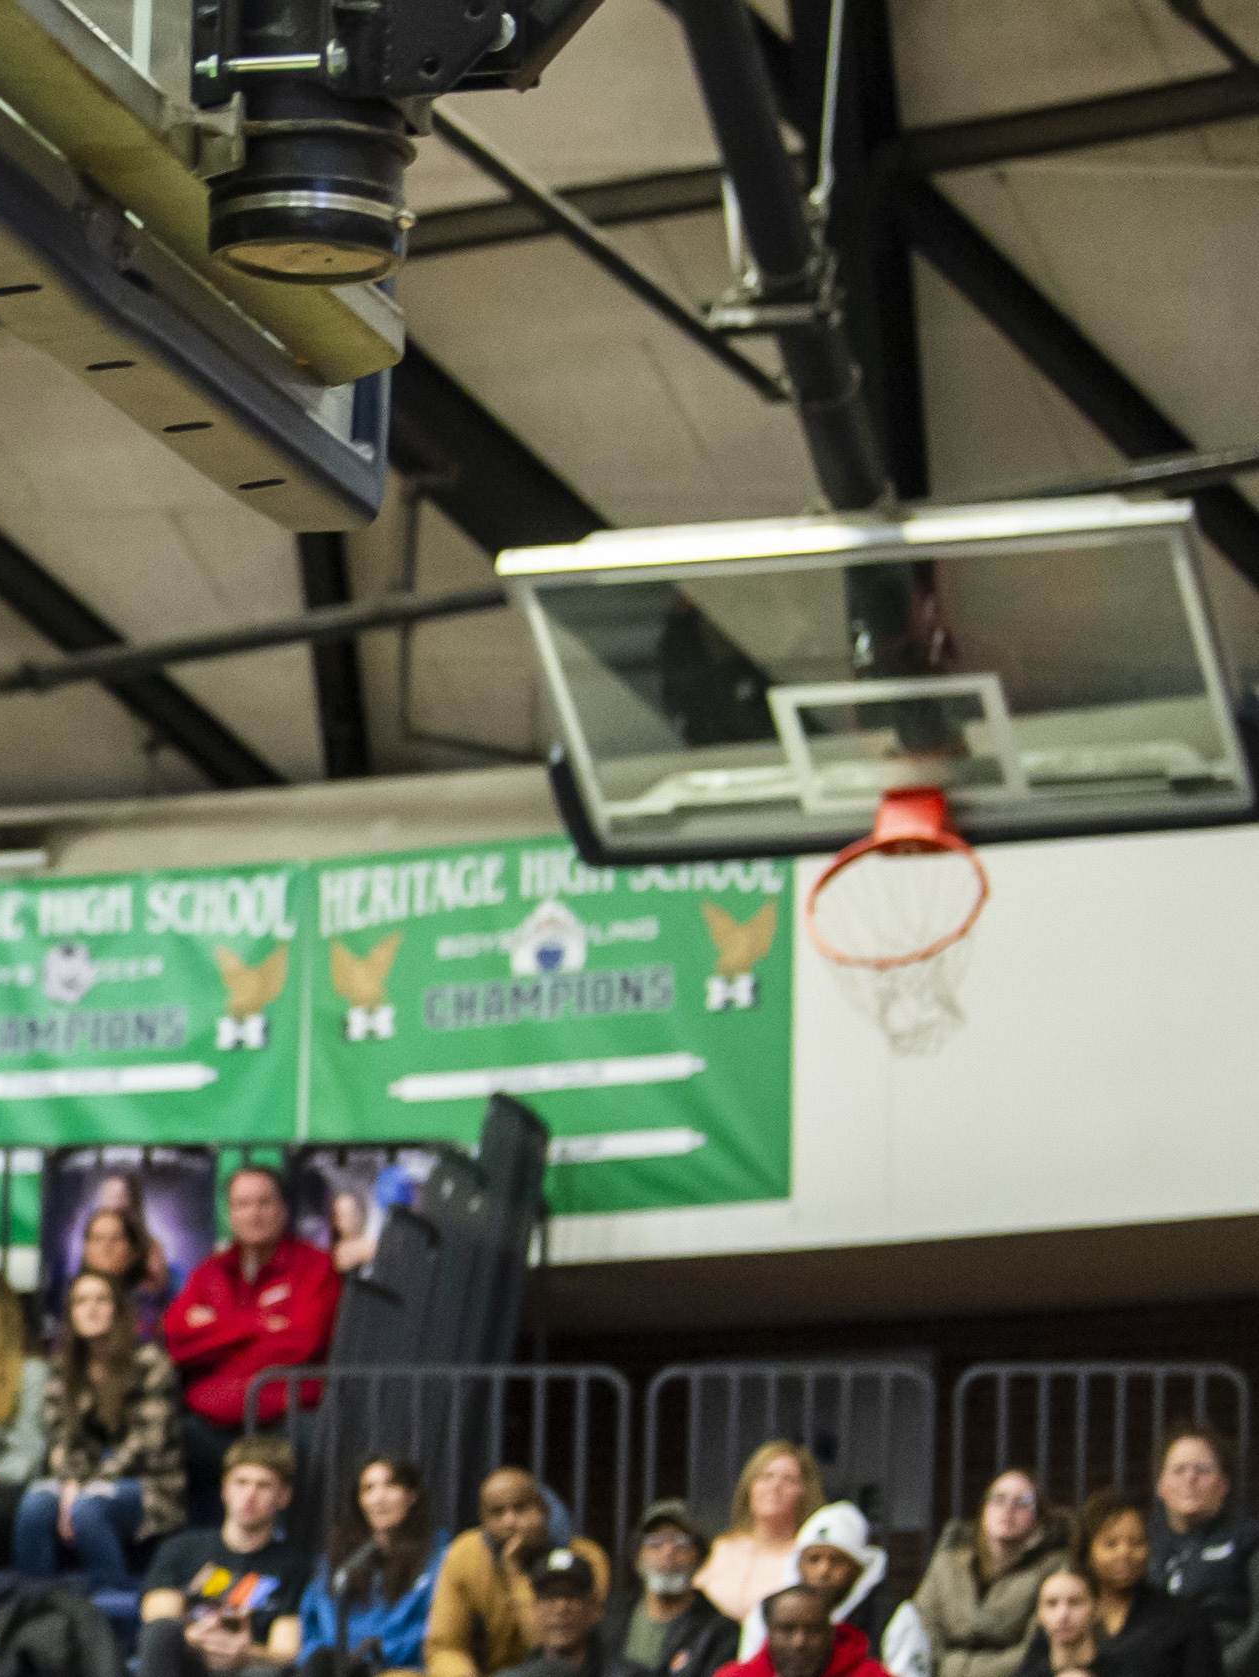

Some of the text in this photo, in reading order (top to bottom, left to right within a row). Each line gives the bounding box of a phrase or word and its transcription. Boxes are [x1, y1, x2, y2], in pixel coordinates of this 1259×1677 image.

[39, 885, 133, 935] HIGH
[145, 873, 297, 940] SCHOOL
[318, 854, 506, 938] HERITAGE
[422, 963, 676, 1031] CHAMPIONS
